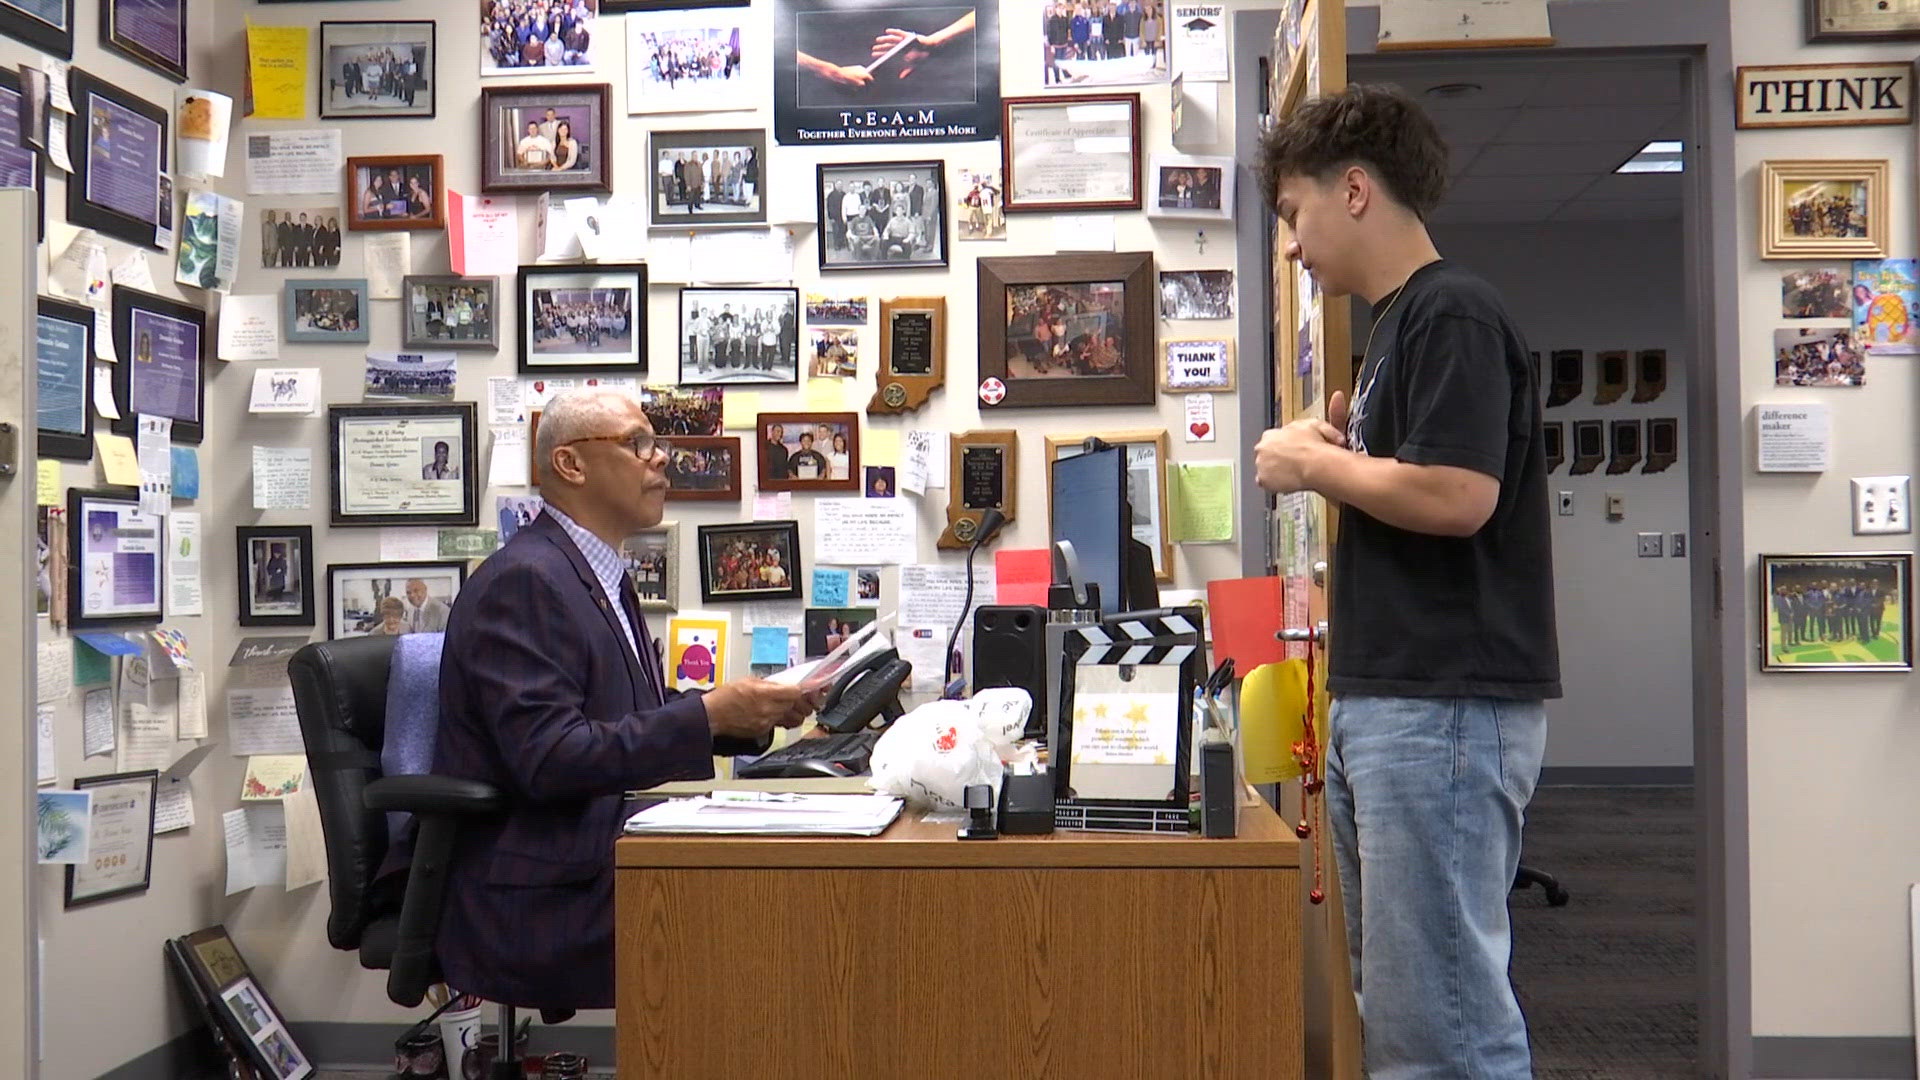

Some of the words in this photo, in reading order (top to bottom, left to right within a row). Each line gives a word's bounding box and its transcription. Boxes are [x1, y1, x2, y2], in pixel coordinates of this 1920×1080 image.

[1750, 76, 1904, 113] THINK
[1177, 353, 1216, 362] THANK
[1184, 367, 1210, 377] YOU!
[1762, 410, 1808, 420] difference
[1762, 421, 1792, 430] maker
